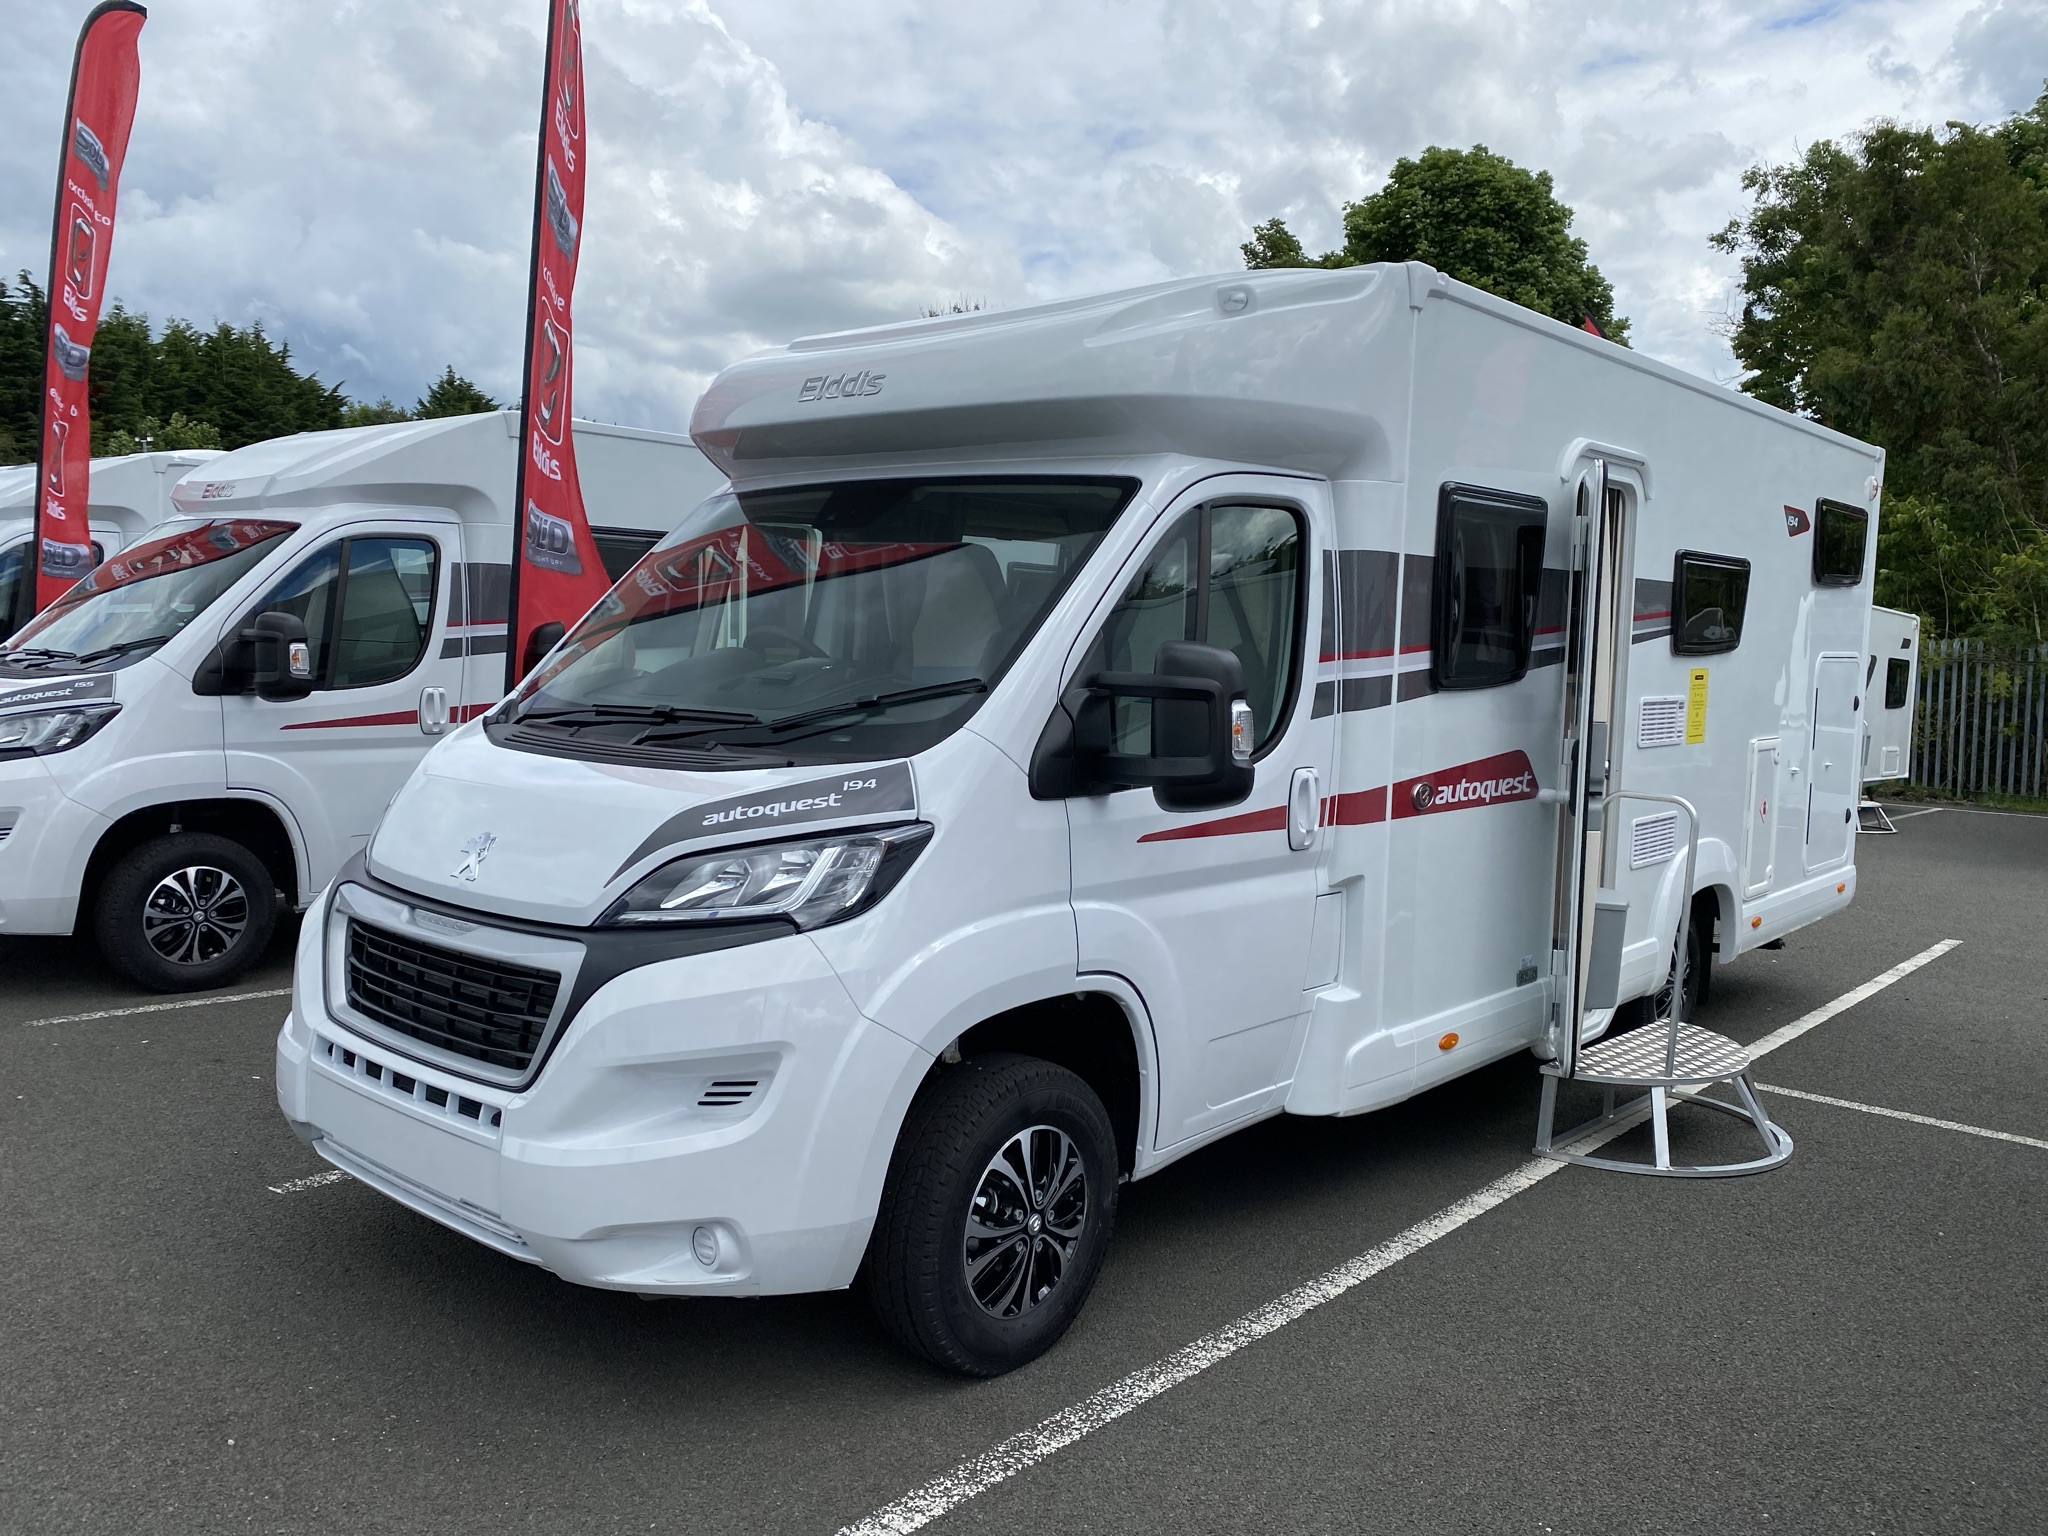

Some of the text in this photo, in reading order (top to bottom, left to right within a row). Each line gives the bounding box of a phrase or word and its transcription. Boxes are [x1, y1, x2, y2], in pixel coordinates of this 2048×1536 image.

[798, 370, 887, 402] Elddis
[0, 688, 74, 704] autoquest
[702, 778, 877, 826] autoquest 194
[1435, 770, 1533, 803] autoquest
